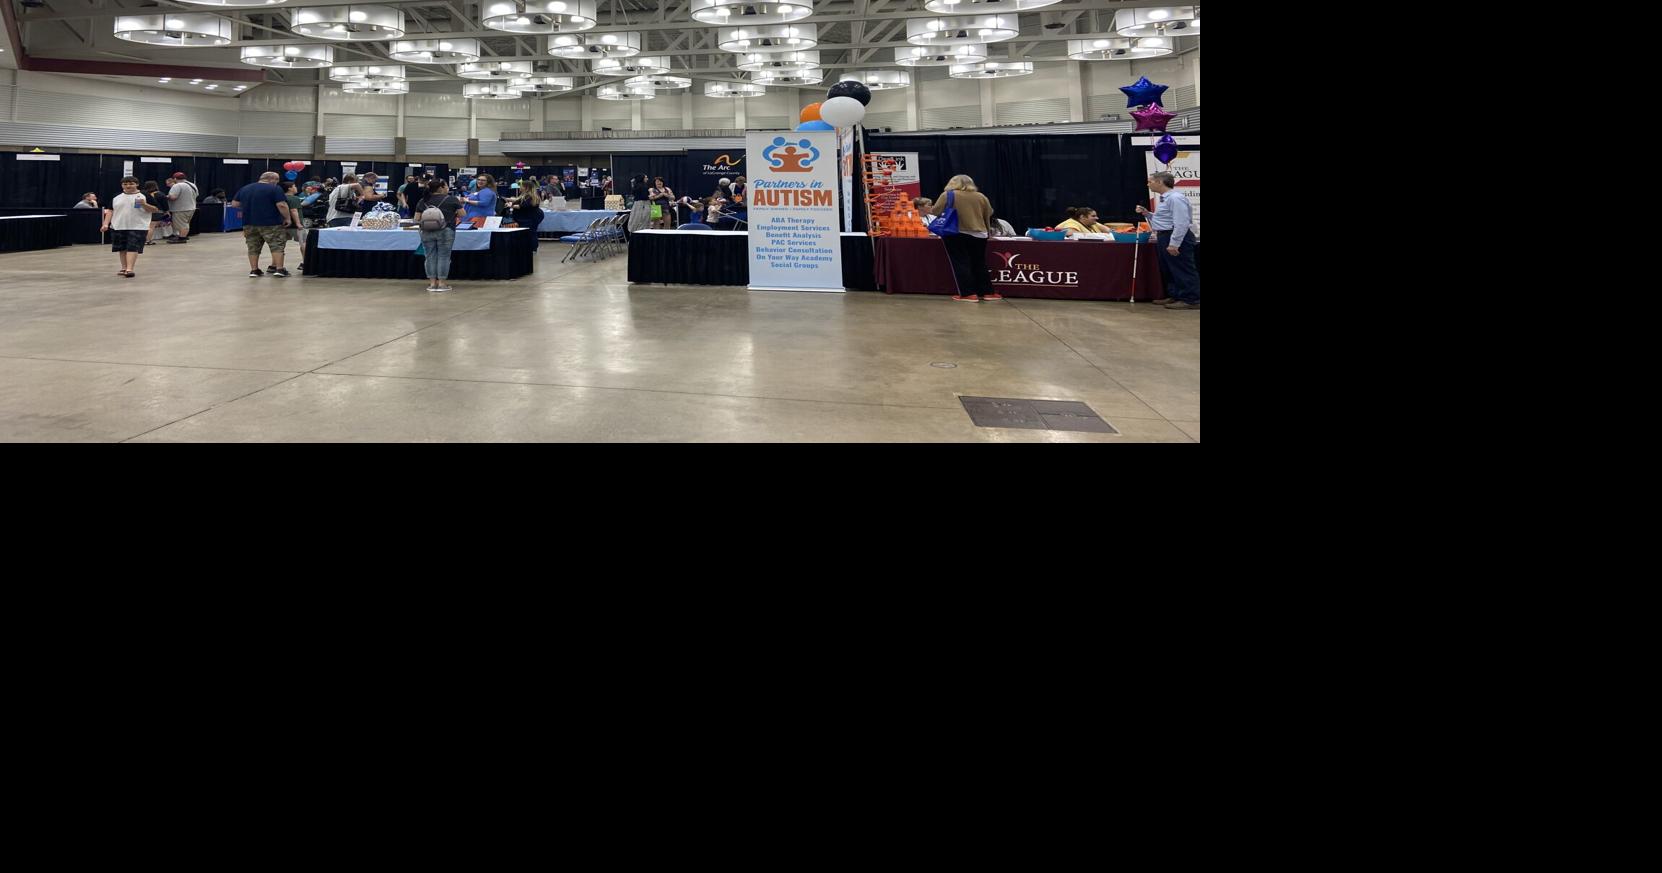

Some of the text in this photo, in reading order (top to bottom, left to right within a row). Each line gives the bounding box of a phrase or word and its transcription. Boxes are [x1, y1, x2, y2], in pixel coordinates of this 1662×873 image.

[753, 179, 823, 188] Partners in
[753, 190, 832, 206] AUTISM
[787, 217, 815, 225] Therapy
